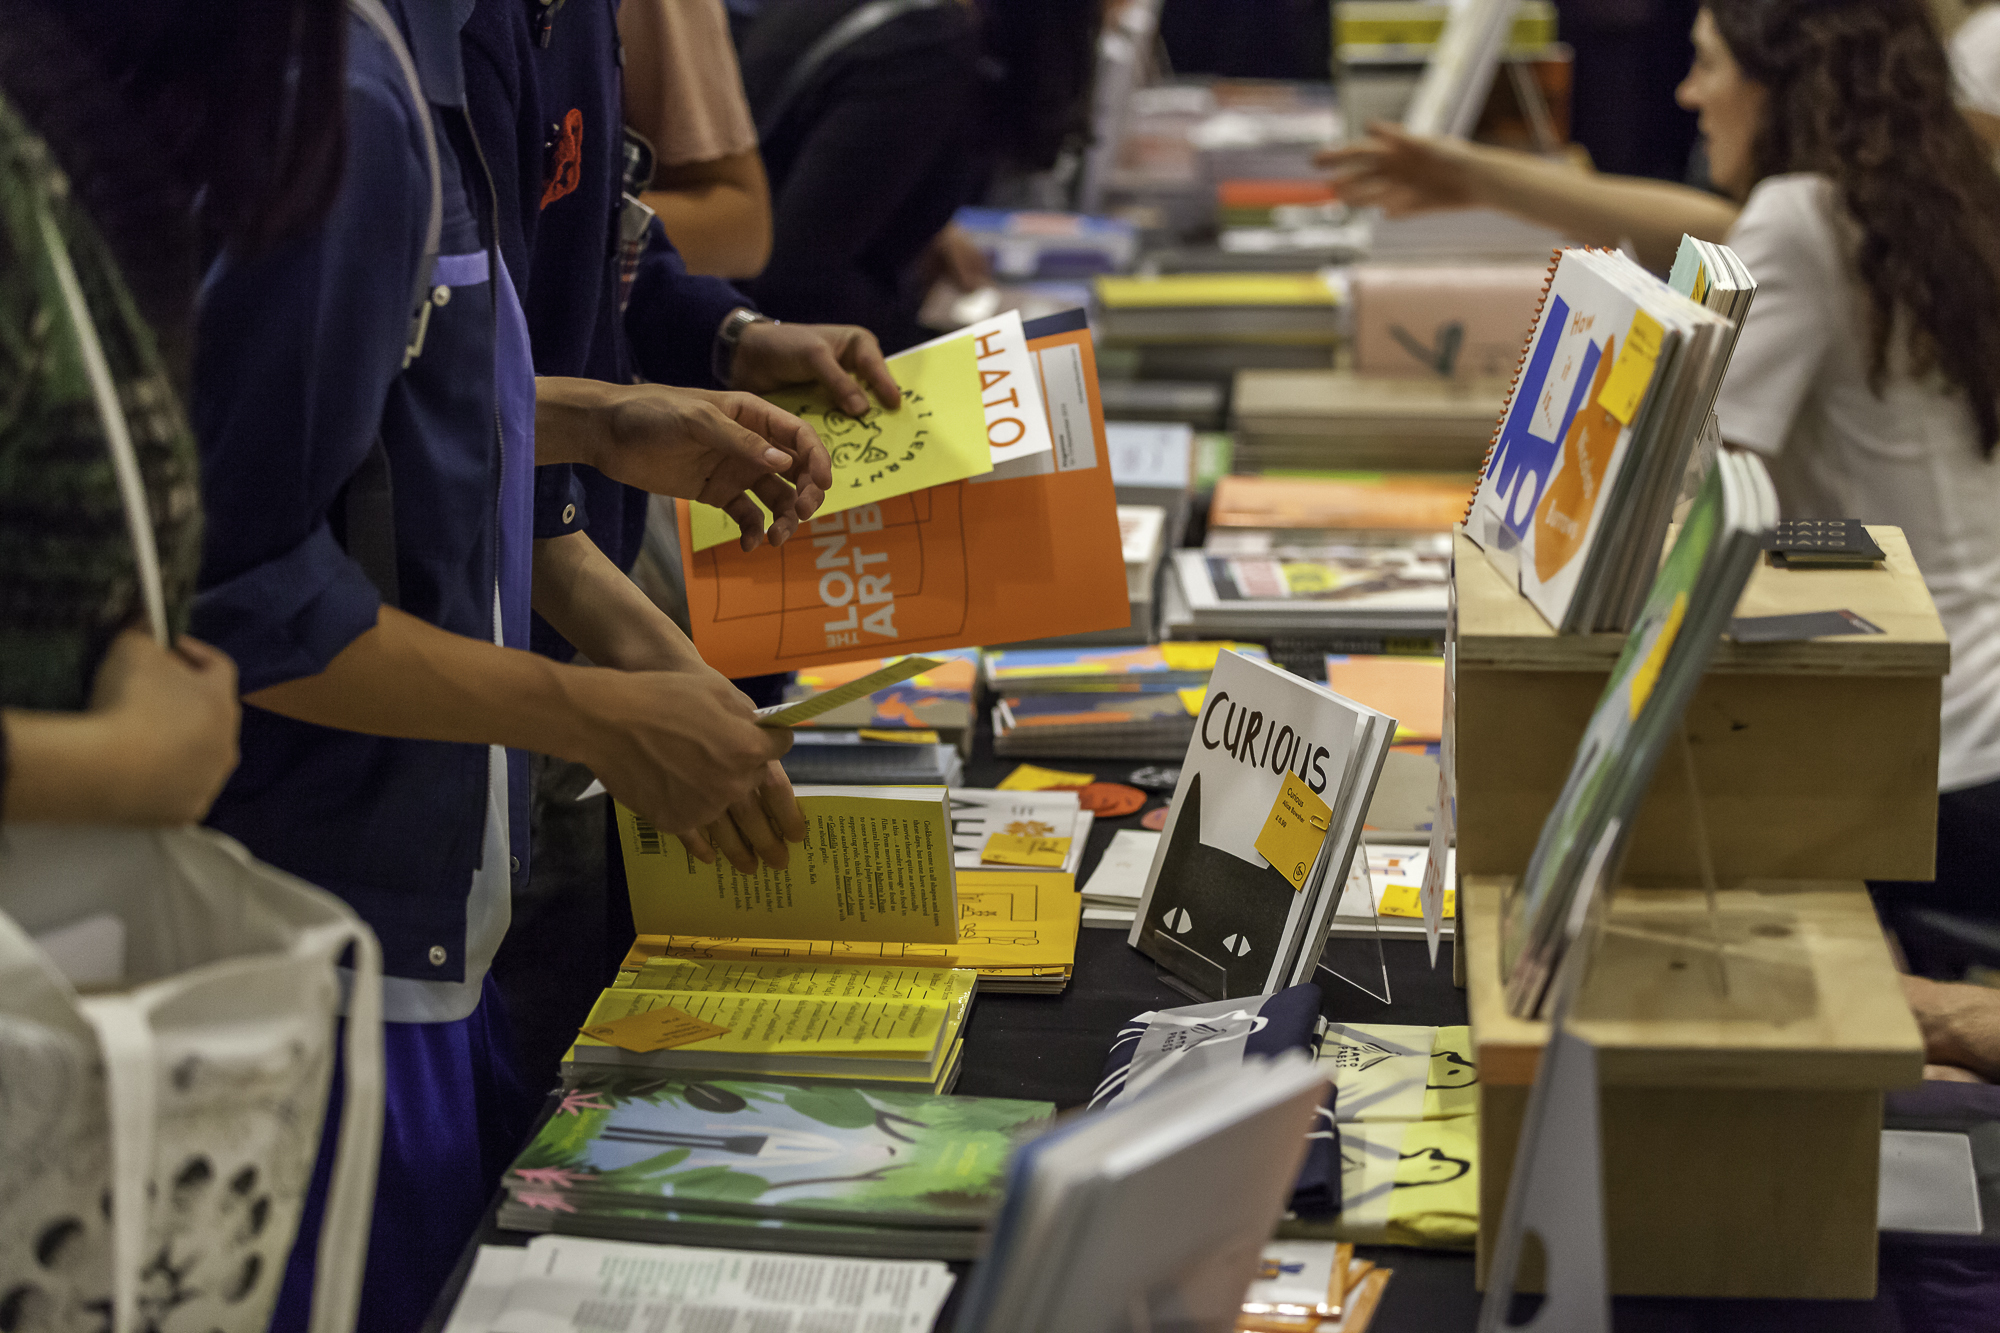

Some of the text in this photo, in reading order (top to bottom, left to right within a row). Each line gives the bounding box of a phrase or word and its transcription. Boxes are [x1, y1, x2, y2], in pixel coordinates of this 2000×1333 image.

[1570, 311, 1595, 336] How
[974, 329, 1026, 448] HATO
[1775, 539, 1846, 547] HATO
[852, 546, 899, 638] ART
[826, 631, 859, 648] THE
[1202, 691, 1330, 795] CURIOUS
[1282, 799, 1291, 812] Alice
[1287, 787, 1304, 808] Curious
[819, 830, 827, 846] sliced
[848, 816, 858, 846] supporting
[871, 822, 879, 841] central
[924, 821, 933, 850] Cookbooks
[841, 836, 850, 867] sandwiches
[862, 838, 870, 854] where
[905, 841, 913, 858] theme
[832, 855, 840, 873] tomato
[895, 849, 903, 866] tender
[905, 860, 913, 874] quite
[741, 874, 751, 895] printed
[864, 868, 873, 882] plays
[895, 867, 905, 889] homage
[856, 879, 864, 897] ironed
[908, 882, 918, 911] artistically
[928, 882, 938, 901] shapes
[858, 899, 866, 911] ham
[920, 889, 929, 916] embraced
[1161, 1031, 1177, 1052] PRESS
[1336, 1046, 1348, 1068] PRESS
[1349, 1047, 1360, 1067] HATO
